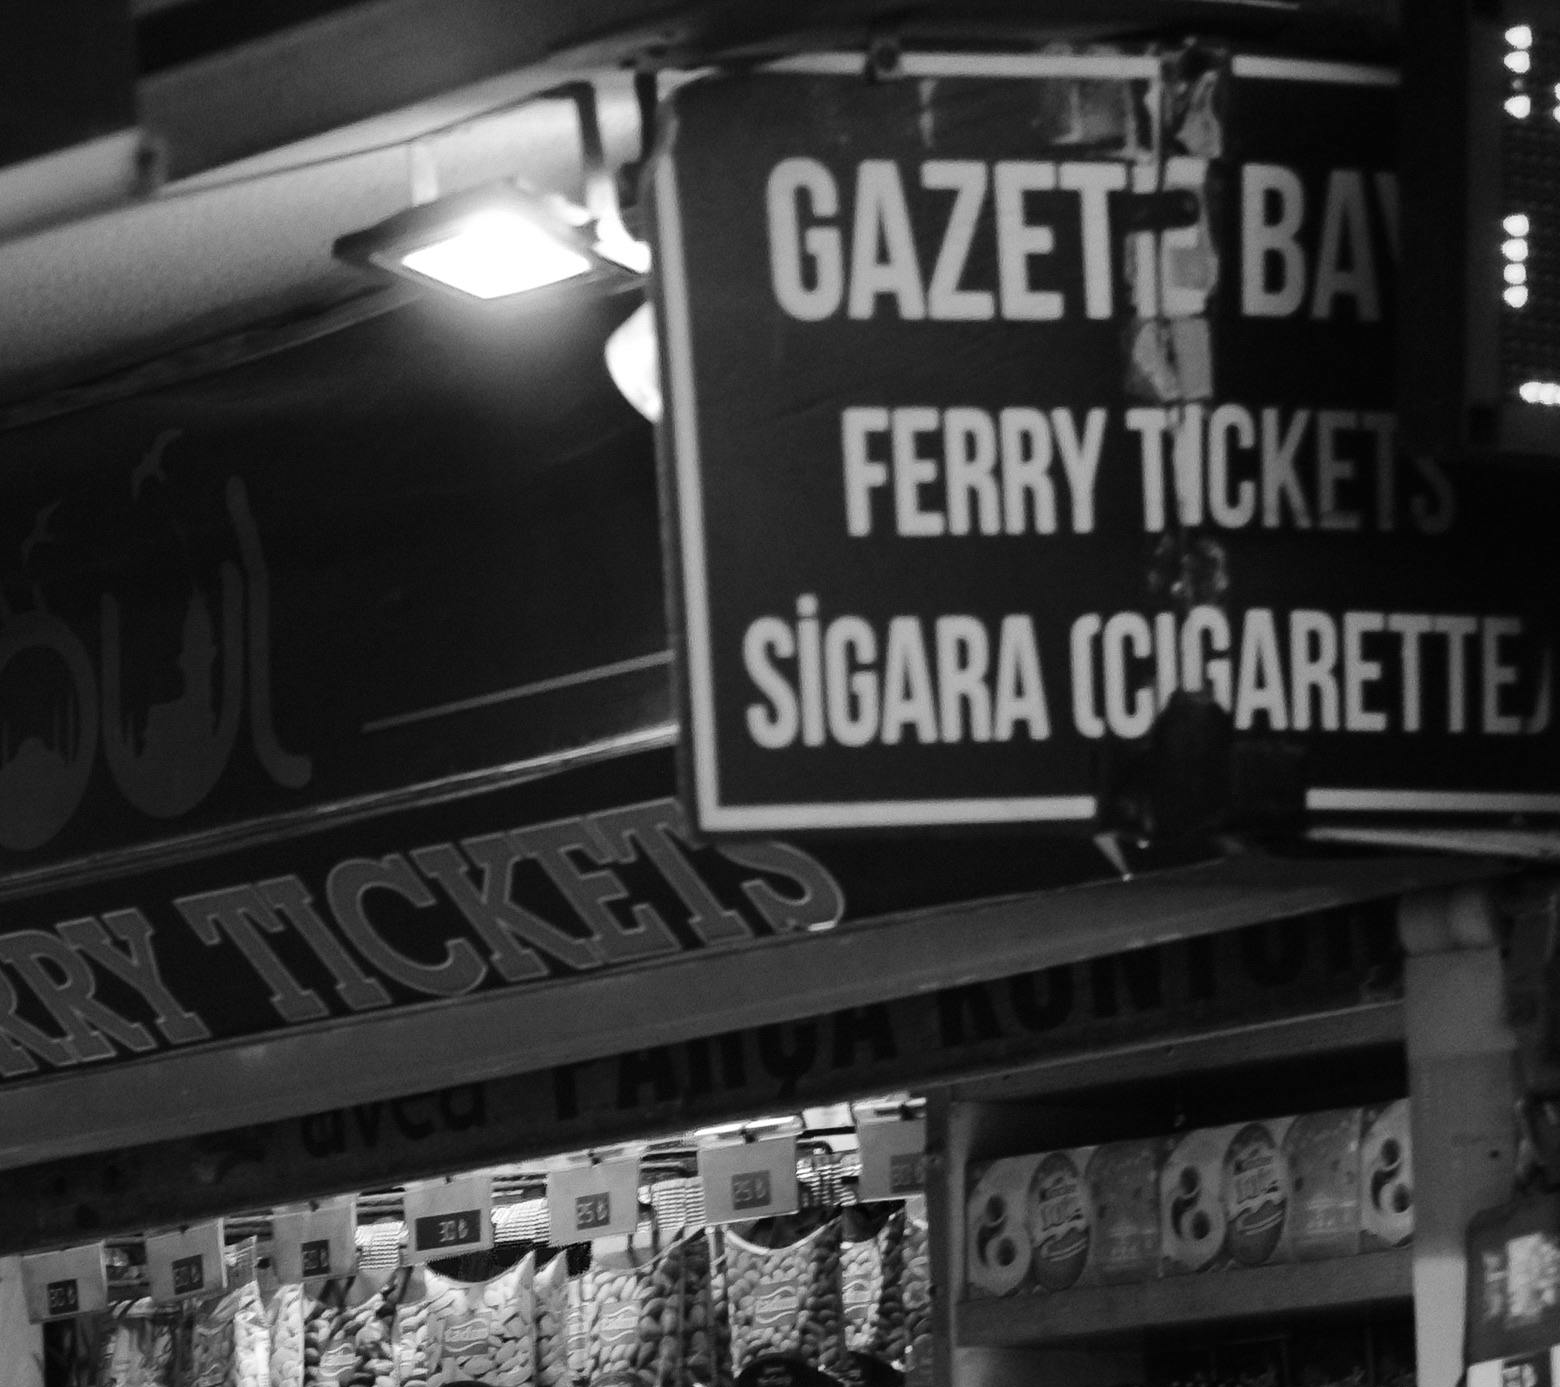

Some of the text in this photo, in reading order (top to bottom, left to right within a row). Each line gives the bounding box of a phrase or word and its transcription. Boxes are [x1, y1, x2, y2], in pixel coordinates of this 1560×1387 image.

[840, 403, 1456, 537] FERRY TICKETS
[742, 593, 1049, 749] SİGARA
[174, 798, 845, 1024] TICKETS
